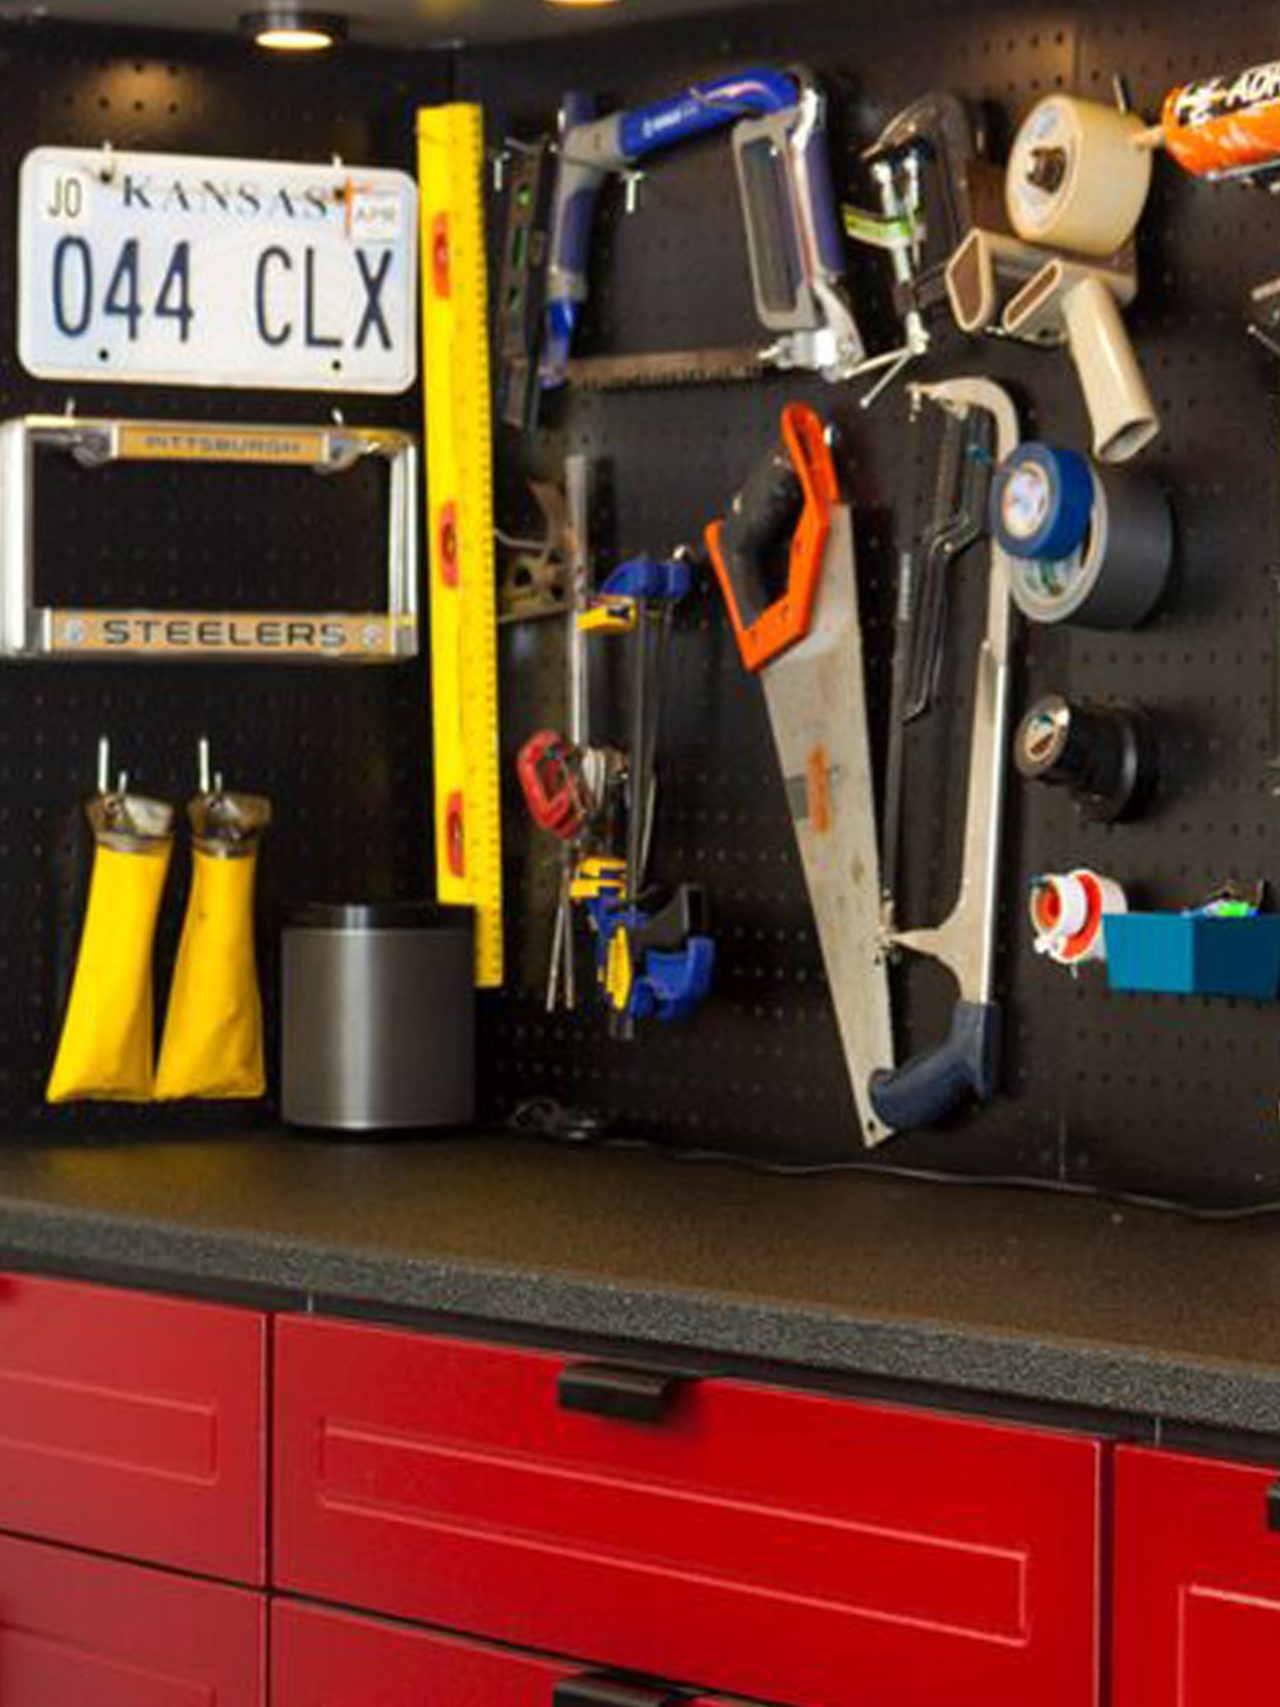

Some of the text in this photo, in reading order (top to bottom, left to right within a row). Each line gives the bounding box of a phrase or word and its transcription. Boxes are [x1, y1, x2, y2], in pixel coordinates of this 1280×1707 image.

[48, 177, 83, 218] JO
[122, 175, 328, 217] KANSAS
[254, 244, 393, 351] CLX
[102, 618, 348, 648] STEELERS
